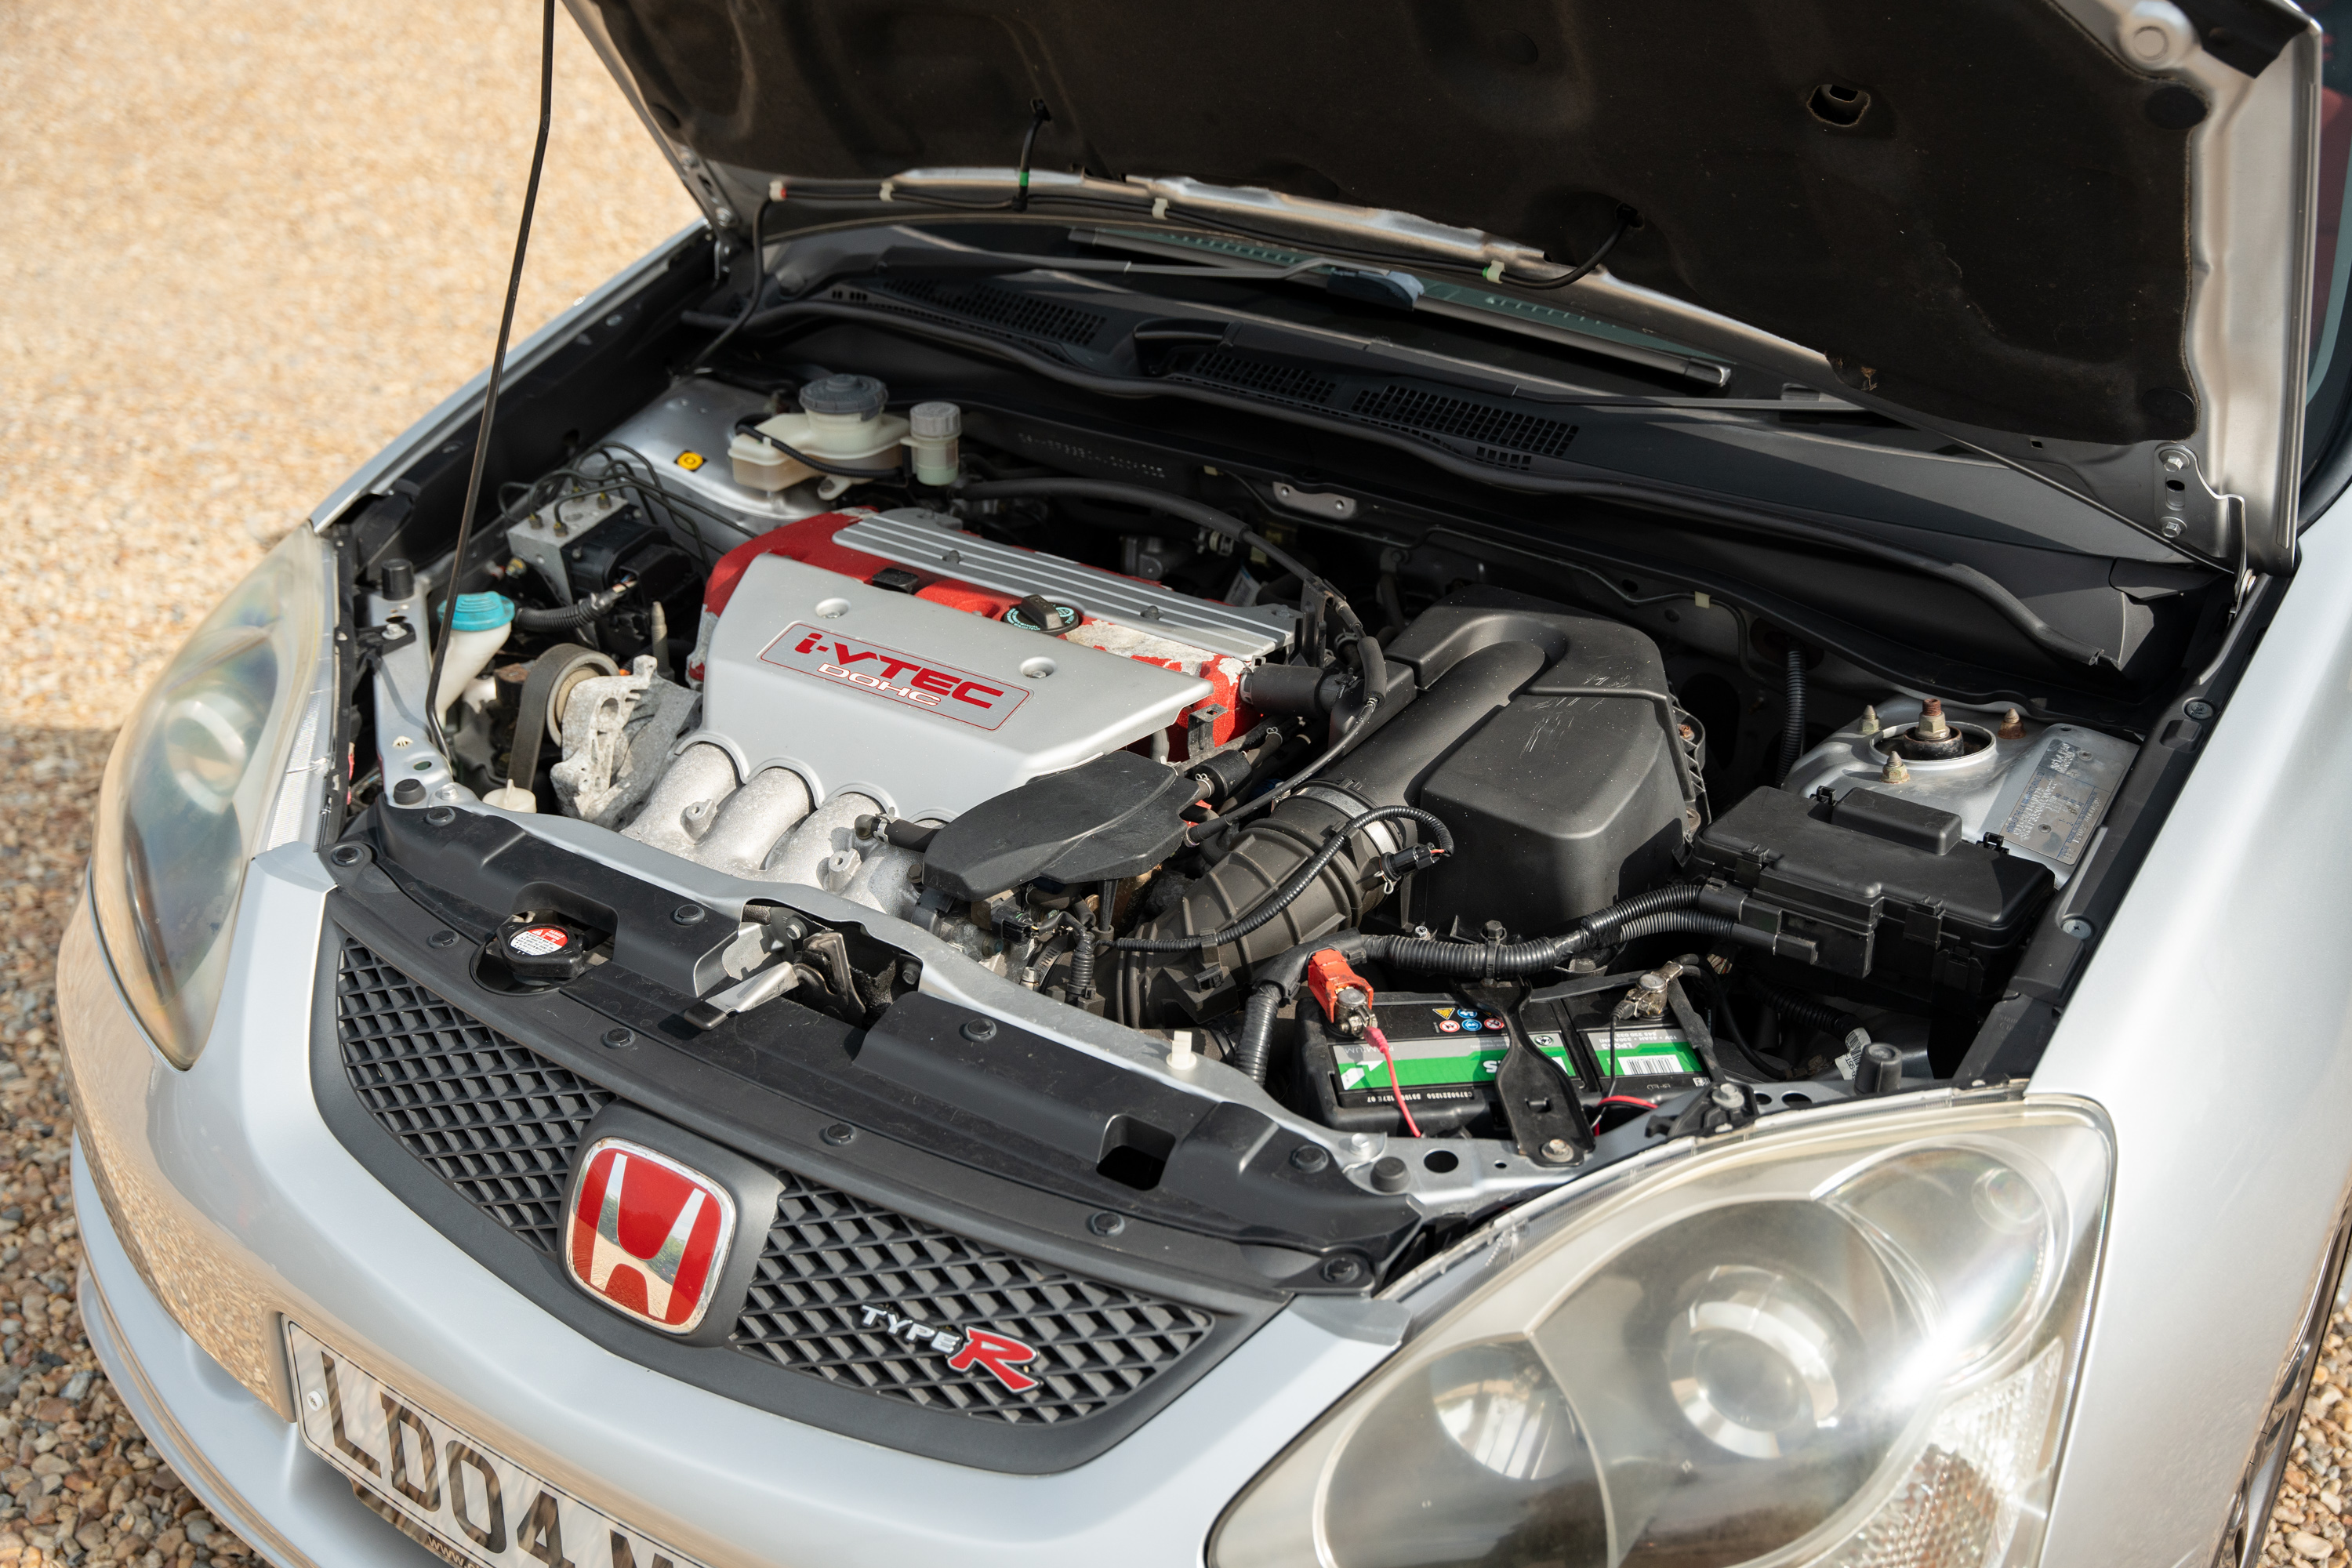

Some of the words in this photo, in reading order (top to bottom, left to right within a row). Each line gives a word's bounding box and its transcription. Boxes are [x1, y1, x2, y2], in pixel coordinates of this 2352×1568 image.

[794, 632, 1004, 710] i-VTEC
[817, 662, 942, 706] DOHC
[862, 1305, 961, 1354] TYPE
[948, 1325, 1040, 1393] R
